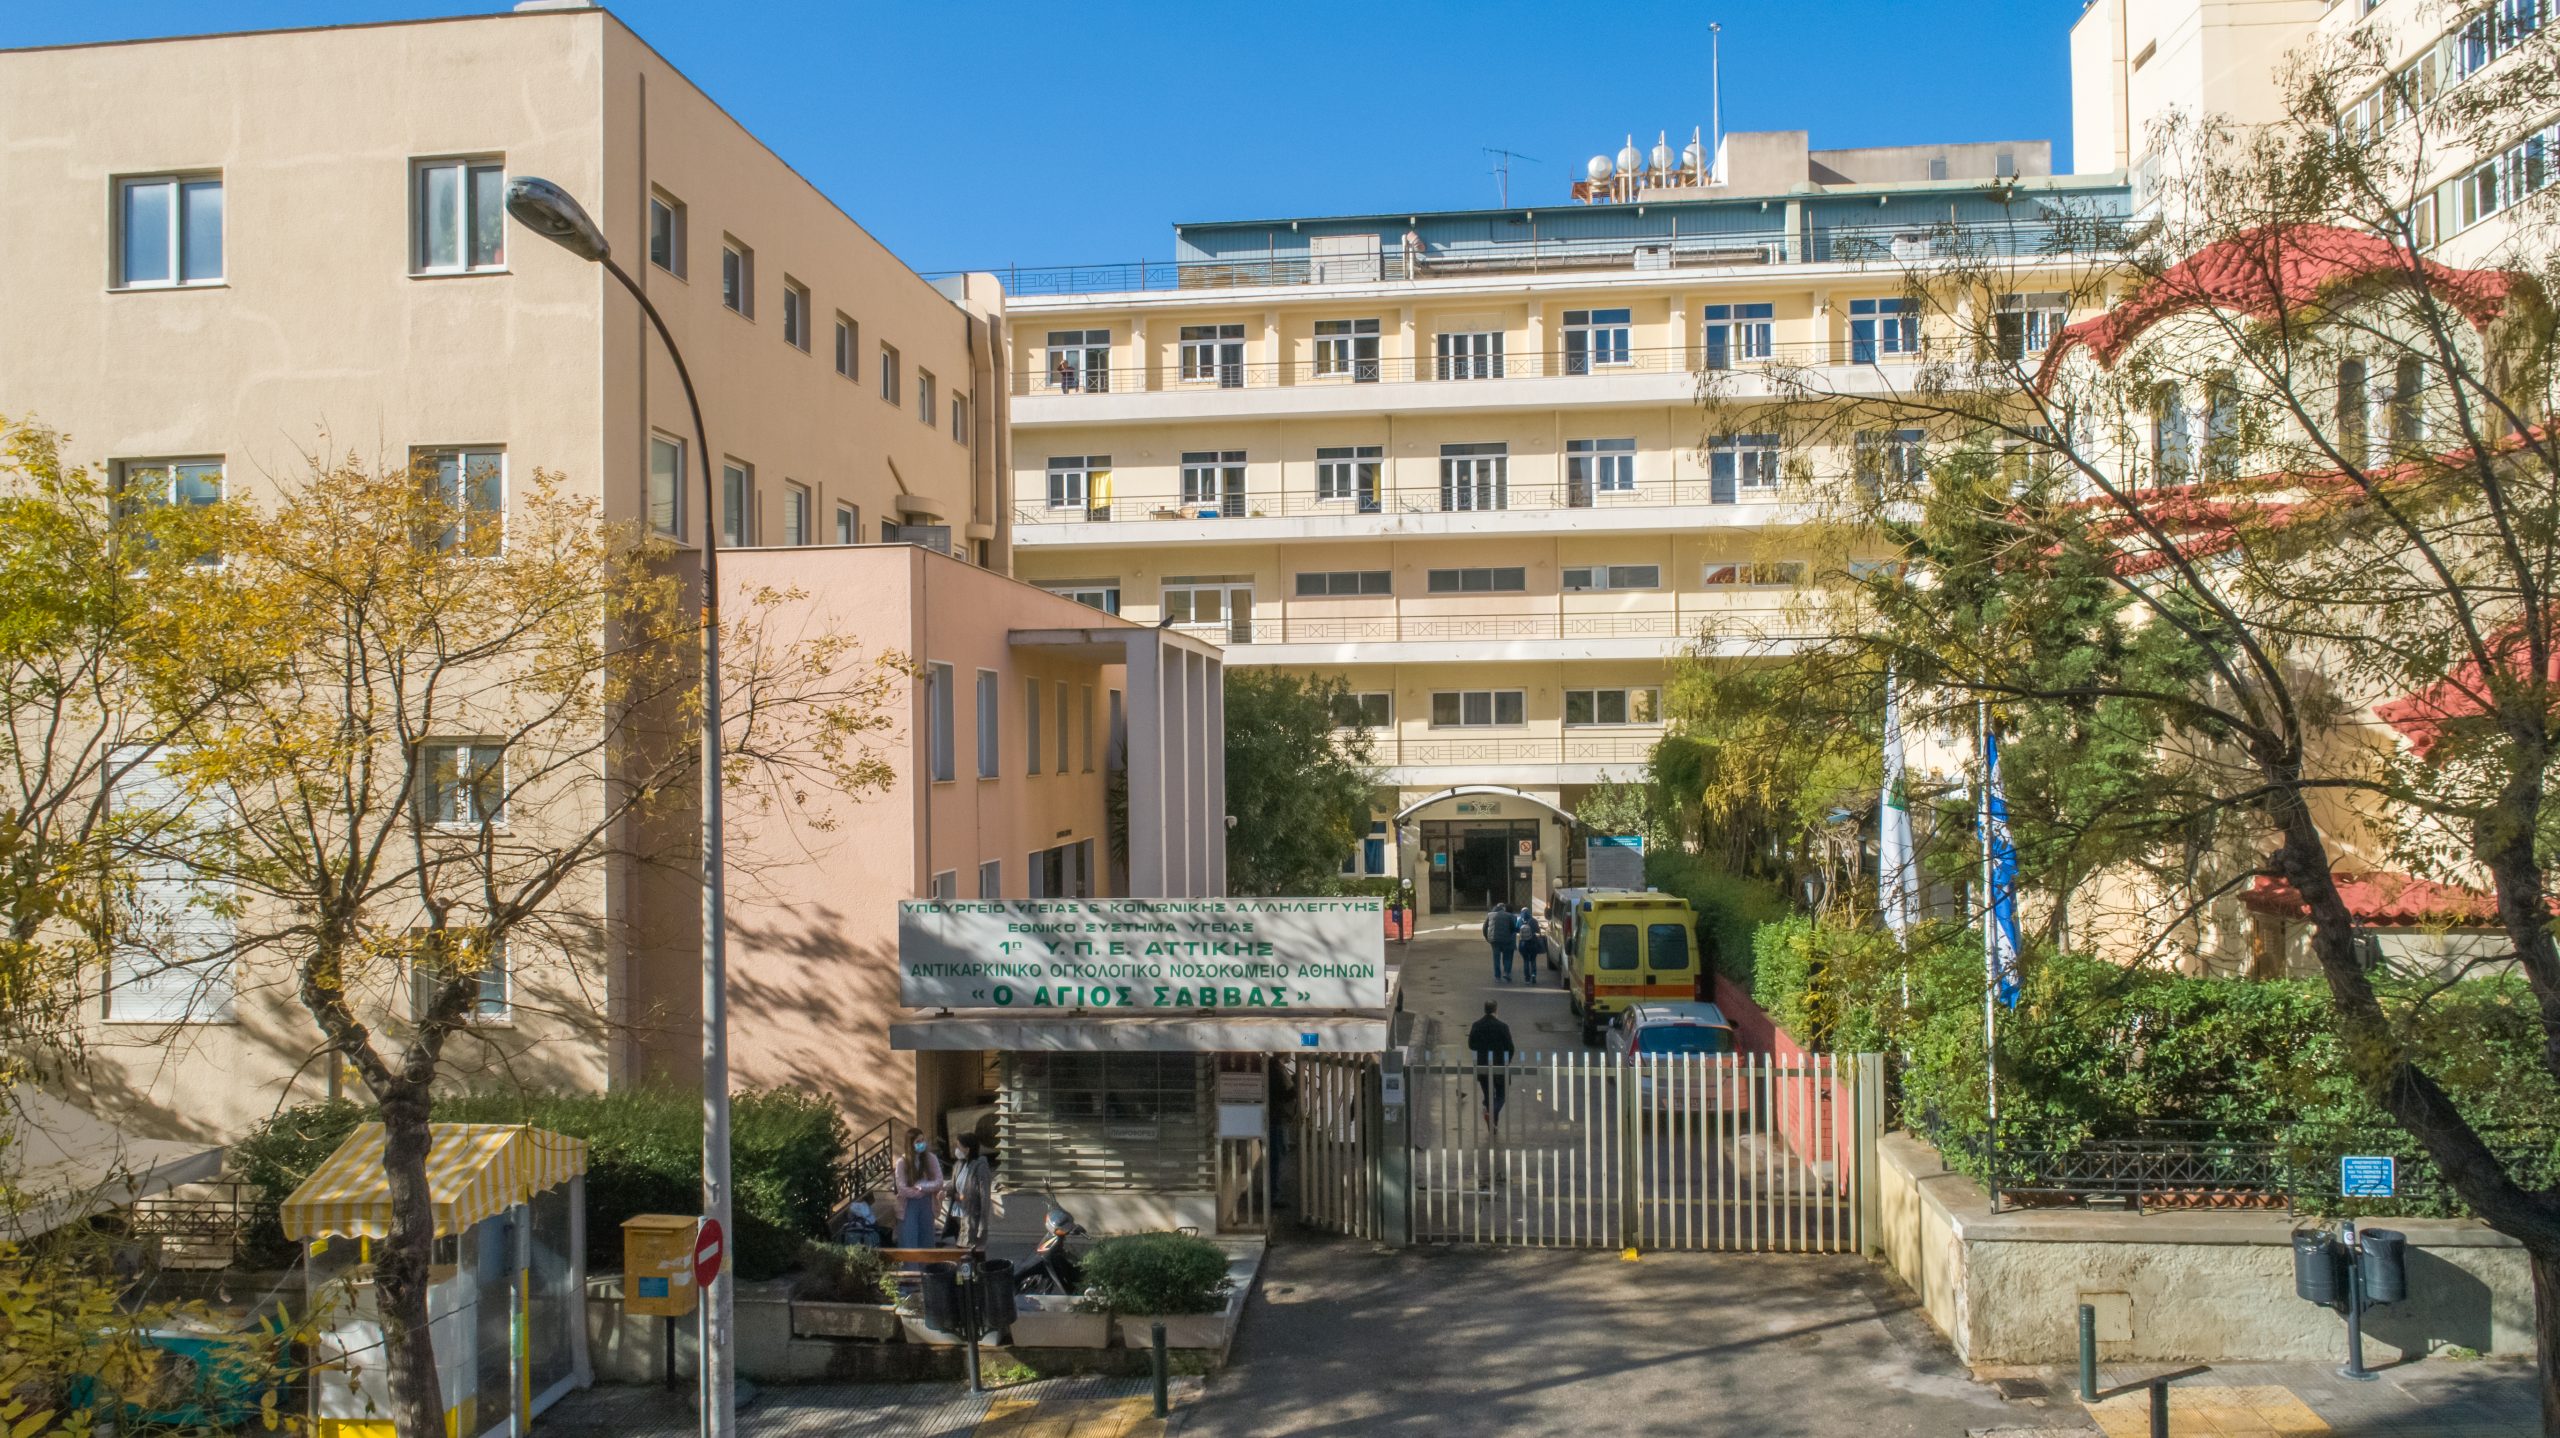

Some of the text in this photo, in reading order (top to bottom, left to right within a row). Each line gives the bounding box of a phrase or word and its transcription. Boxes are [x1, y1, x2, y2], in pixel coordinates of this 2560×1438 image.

[904, 902, 1380, 913] ΥΠΟΥΡΓΕΙΟ ΥΓΕΙΑΣ & ΚΟΙΝΩΝΙΚΗΣ ΑΛΛΗΛΕΓΓΥΗΣ
[1008, 922, 1254, 933] ΕΘΝΙΚΟ ΣΥΣΤΗΜΑ ΥΓΕΙΑΣ
[1145, 941, 1274, 956] ΑΤΤΙΚΗΣ
[911, 963, 1375, 978] ΑΝΤΙΚΑΡΚΙΝΙΚΟ ΟΓΚΟΛΟΓΙΚΟ ΝΟΣΟΚΟΜΕΙΟ ΑΘΗΝΩΝ
[1033, 985, 1134, 1007] ΑΓΙΟΣ
